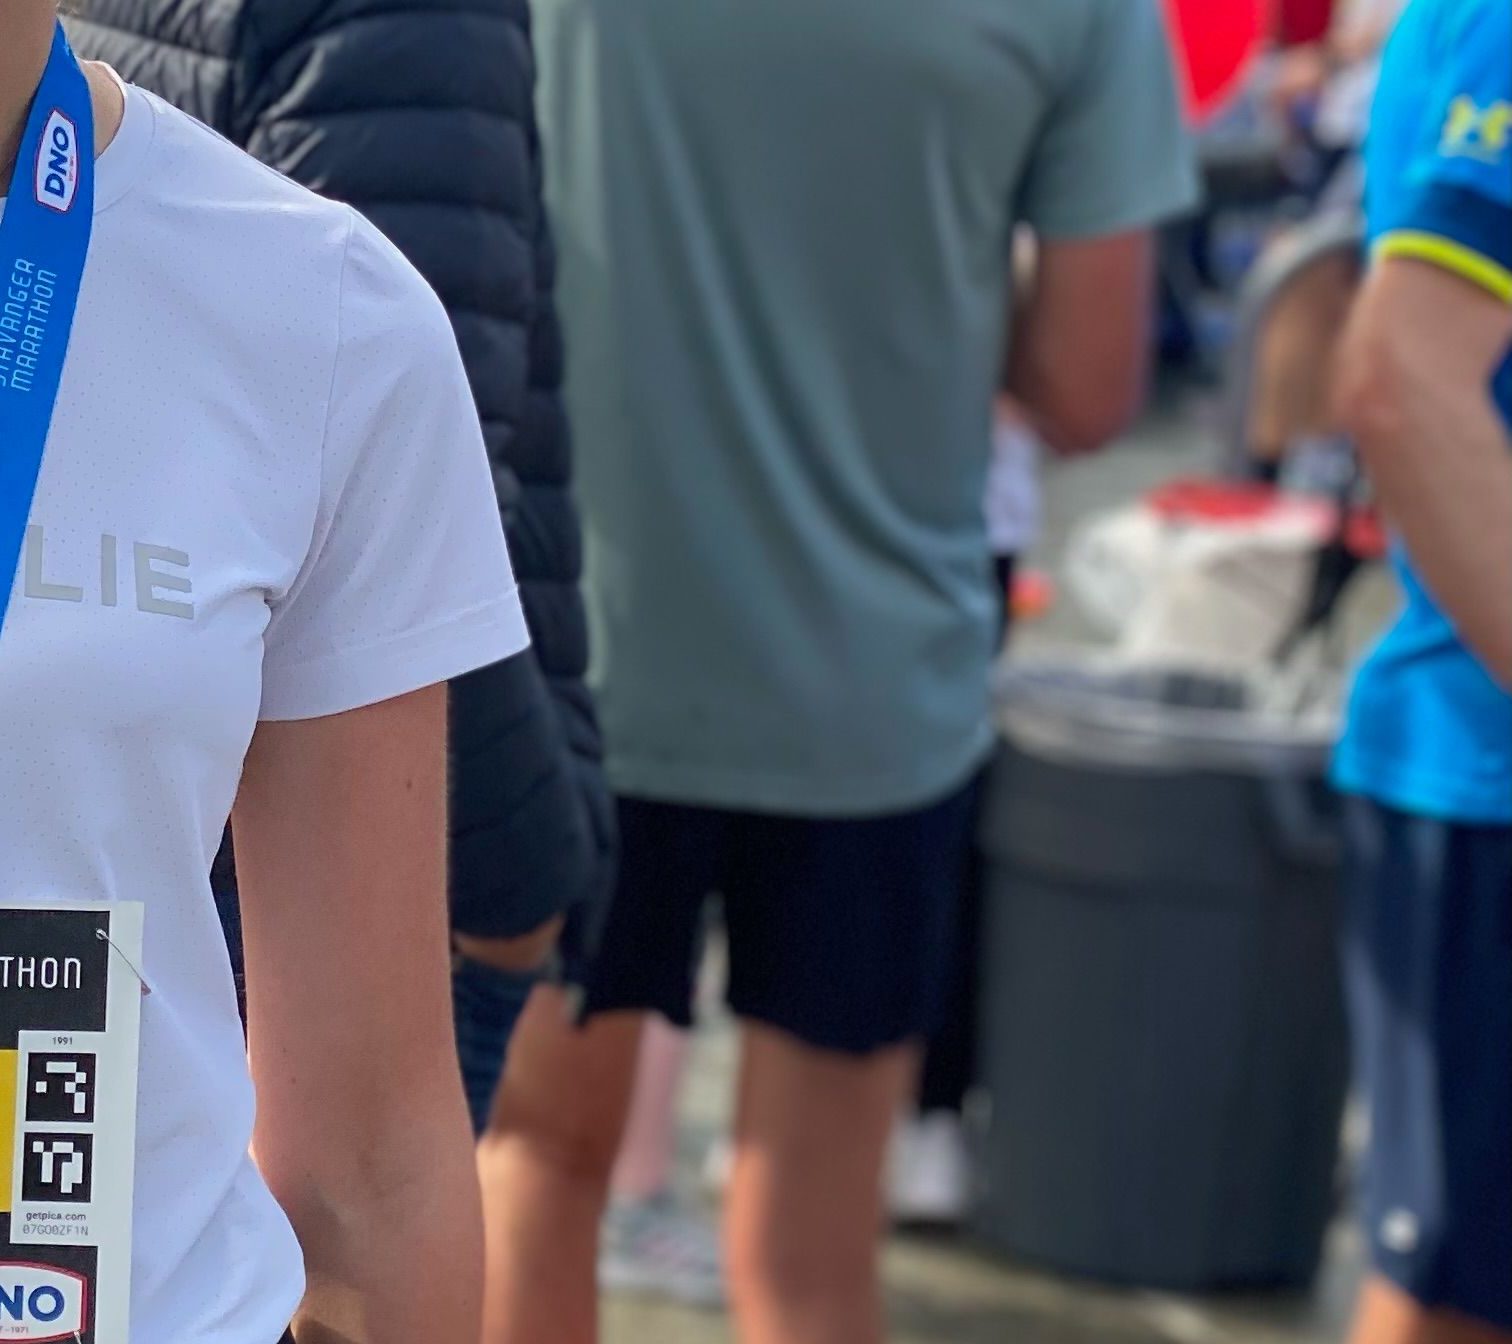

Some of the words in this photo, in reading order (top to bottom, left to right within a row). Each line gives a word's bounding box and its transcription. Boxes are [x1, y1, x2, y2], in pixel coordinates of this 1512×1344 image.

[44, 126, 69, 198] DNO
[11, 269, 57, 392] MARATHON
[52, 1036, 74, 1046] 1991
[26, 1210, 87, 1222] getpica.com
